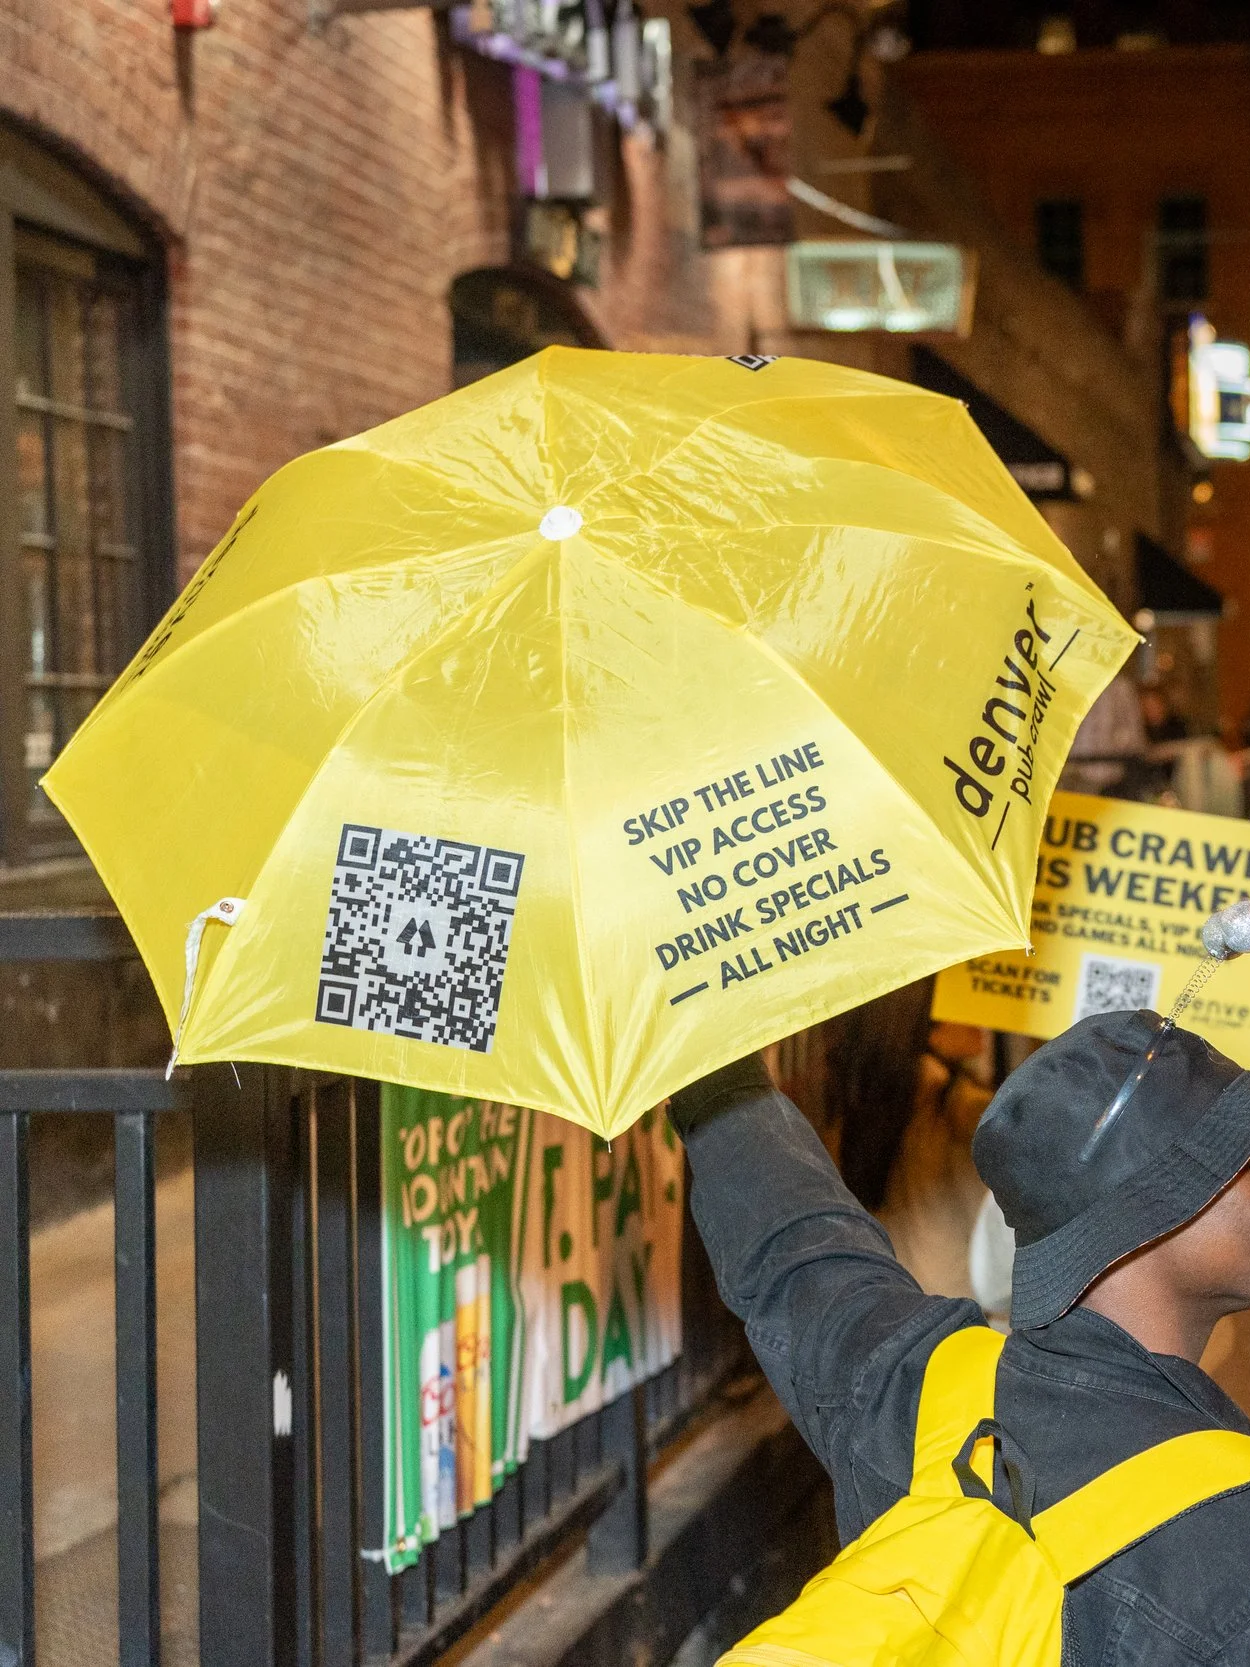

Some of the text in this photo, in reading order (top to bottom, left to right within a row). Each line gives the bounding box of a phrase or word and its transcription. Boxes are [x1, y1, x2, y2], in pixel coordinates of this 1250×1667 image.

[943, 598, 1052, 818] denver
[1010, 669, 1057, 805] pub crawl
[623, 741, 825, 846] SKIP THE LINE
[649, 785, 827, 877] VIP ACCESS
[1043, 815, 1100, 853] UB
[654, 848, 891, 972] DRINK SPECIALS
[676, 827, 838, 914] NO COVER
[1035, 855, 1072, 890] IS
[720, 902, 863, 990] ALL NIGHT
[1023, 966, 1062, 986] FOR
[1063, 921, 1130, 947] GAMES
[1135, 931, 1168, 954] ALL
[971, 976, 1052, 1003] TICKETS
